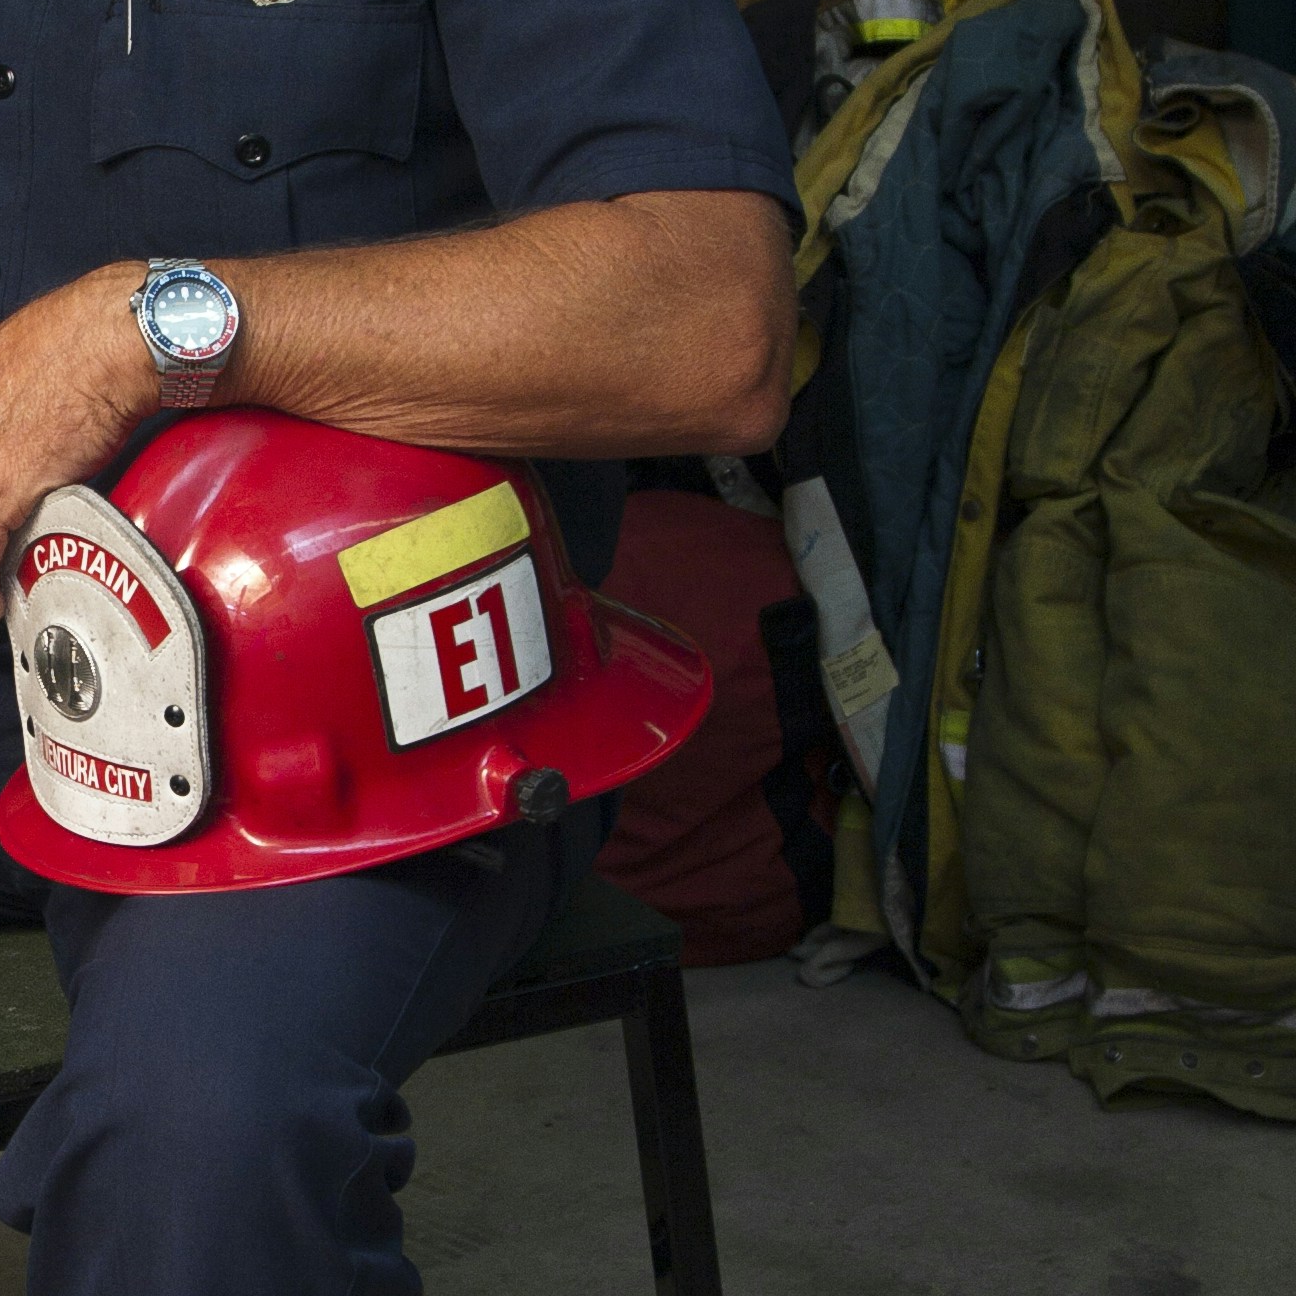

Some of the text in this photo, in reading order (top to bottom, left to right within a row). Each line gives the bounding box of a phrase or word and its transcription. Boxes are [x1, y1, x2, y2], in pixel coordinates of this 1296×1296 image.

[33, 537, 139, 604] CAPTAIN
[429, 582, 521, 720] E1
[104, 764, 148, 801] CITY
